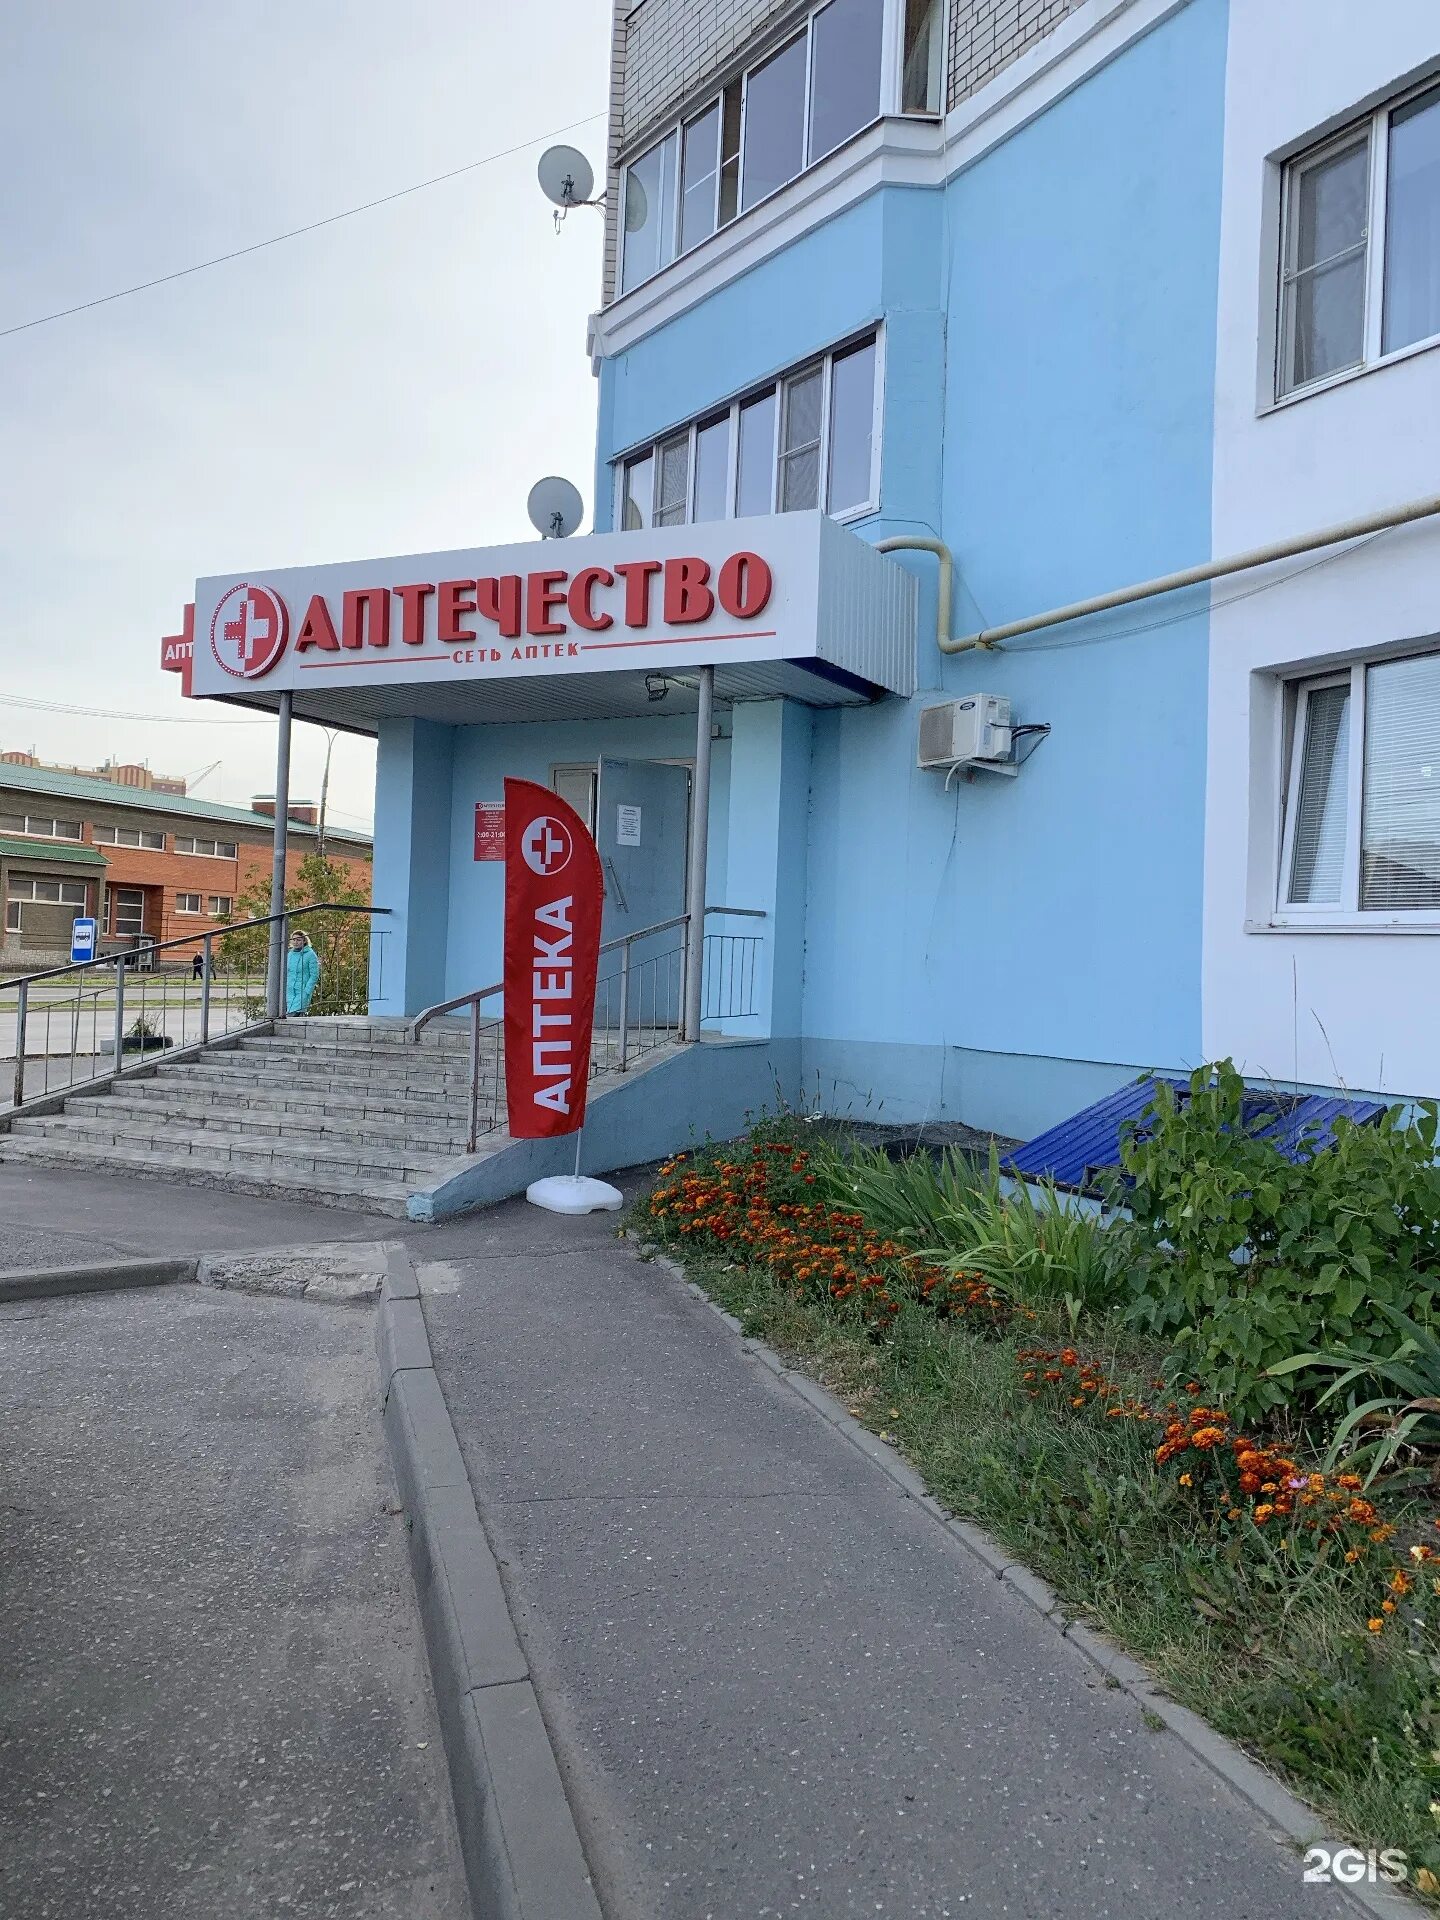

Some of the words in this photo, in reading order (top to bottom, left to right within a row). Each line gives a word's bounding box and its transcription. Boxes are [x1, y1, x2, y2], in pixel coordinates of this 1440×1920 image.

[294, 551, 772, 653] АПТЕЧЕСТВО
[453, 648, 501, 664] СЕТЬ
[511, 642, 578, 660] АПТЕК
[533, 895, 573, 1115] АПТЕКА
